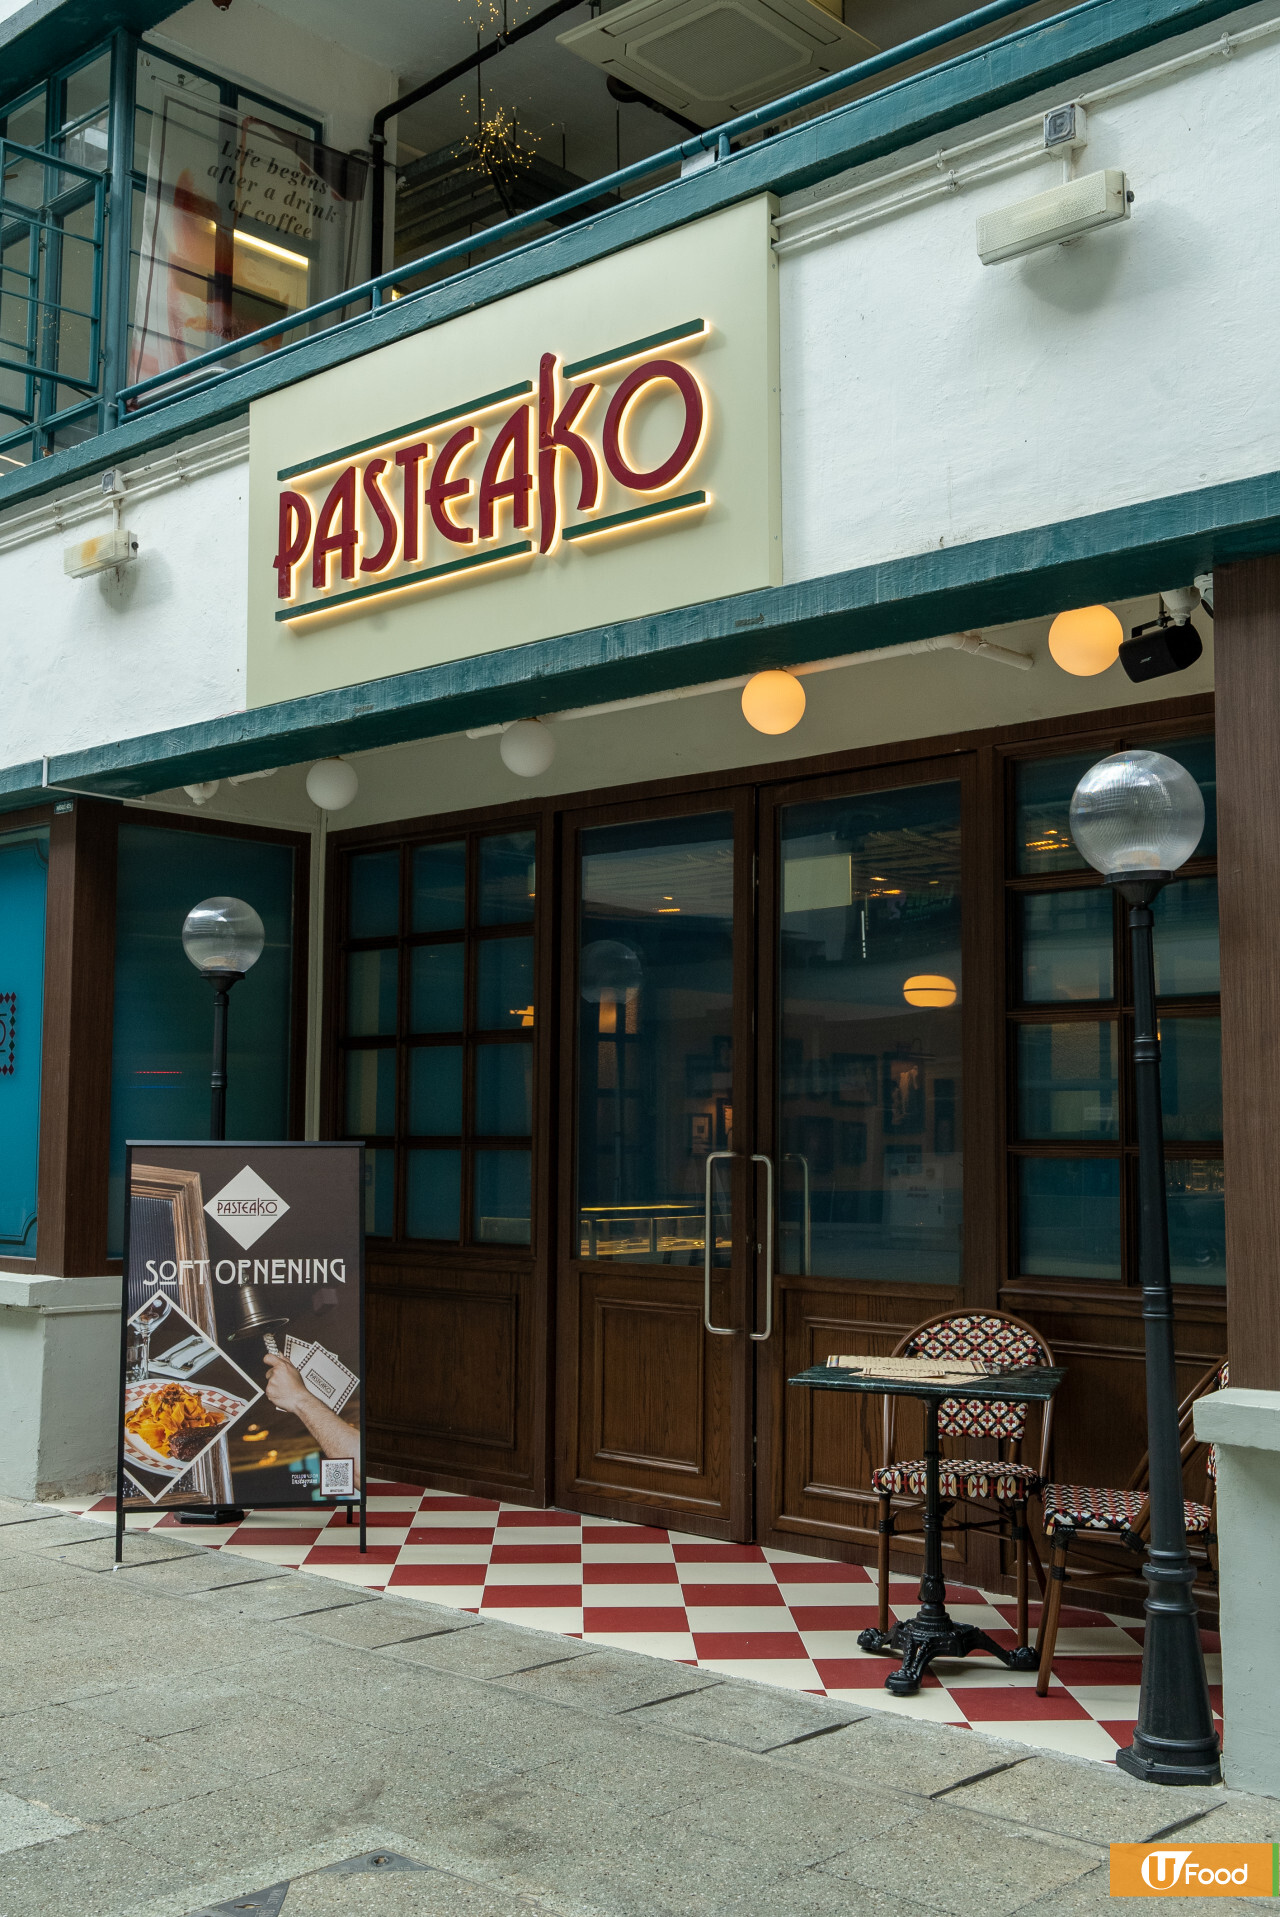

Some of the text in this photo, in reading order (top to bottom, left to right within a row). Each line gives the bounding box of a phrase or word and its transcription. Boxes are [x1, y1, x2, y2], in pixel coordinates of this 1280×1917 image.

[221, 140, 329, 195] Life begins
[207, 164, 338, 224] after a drink
[227, 199, 312, 239] of coffee
[273, 352, 704, 600] PASTEAKO
[216, 1198, 278, 1216] PASTEAKO
[143, 1258, 346, 1286] SOFT OPNENING
